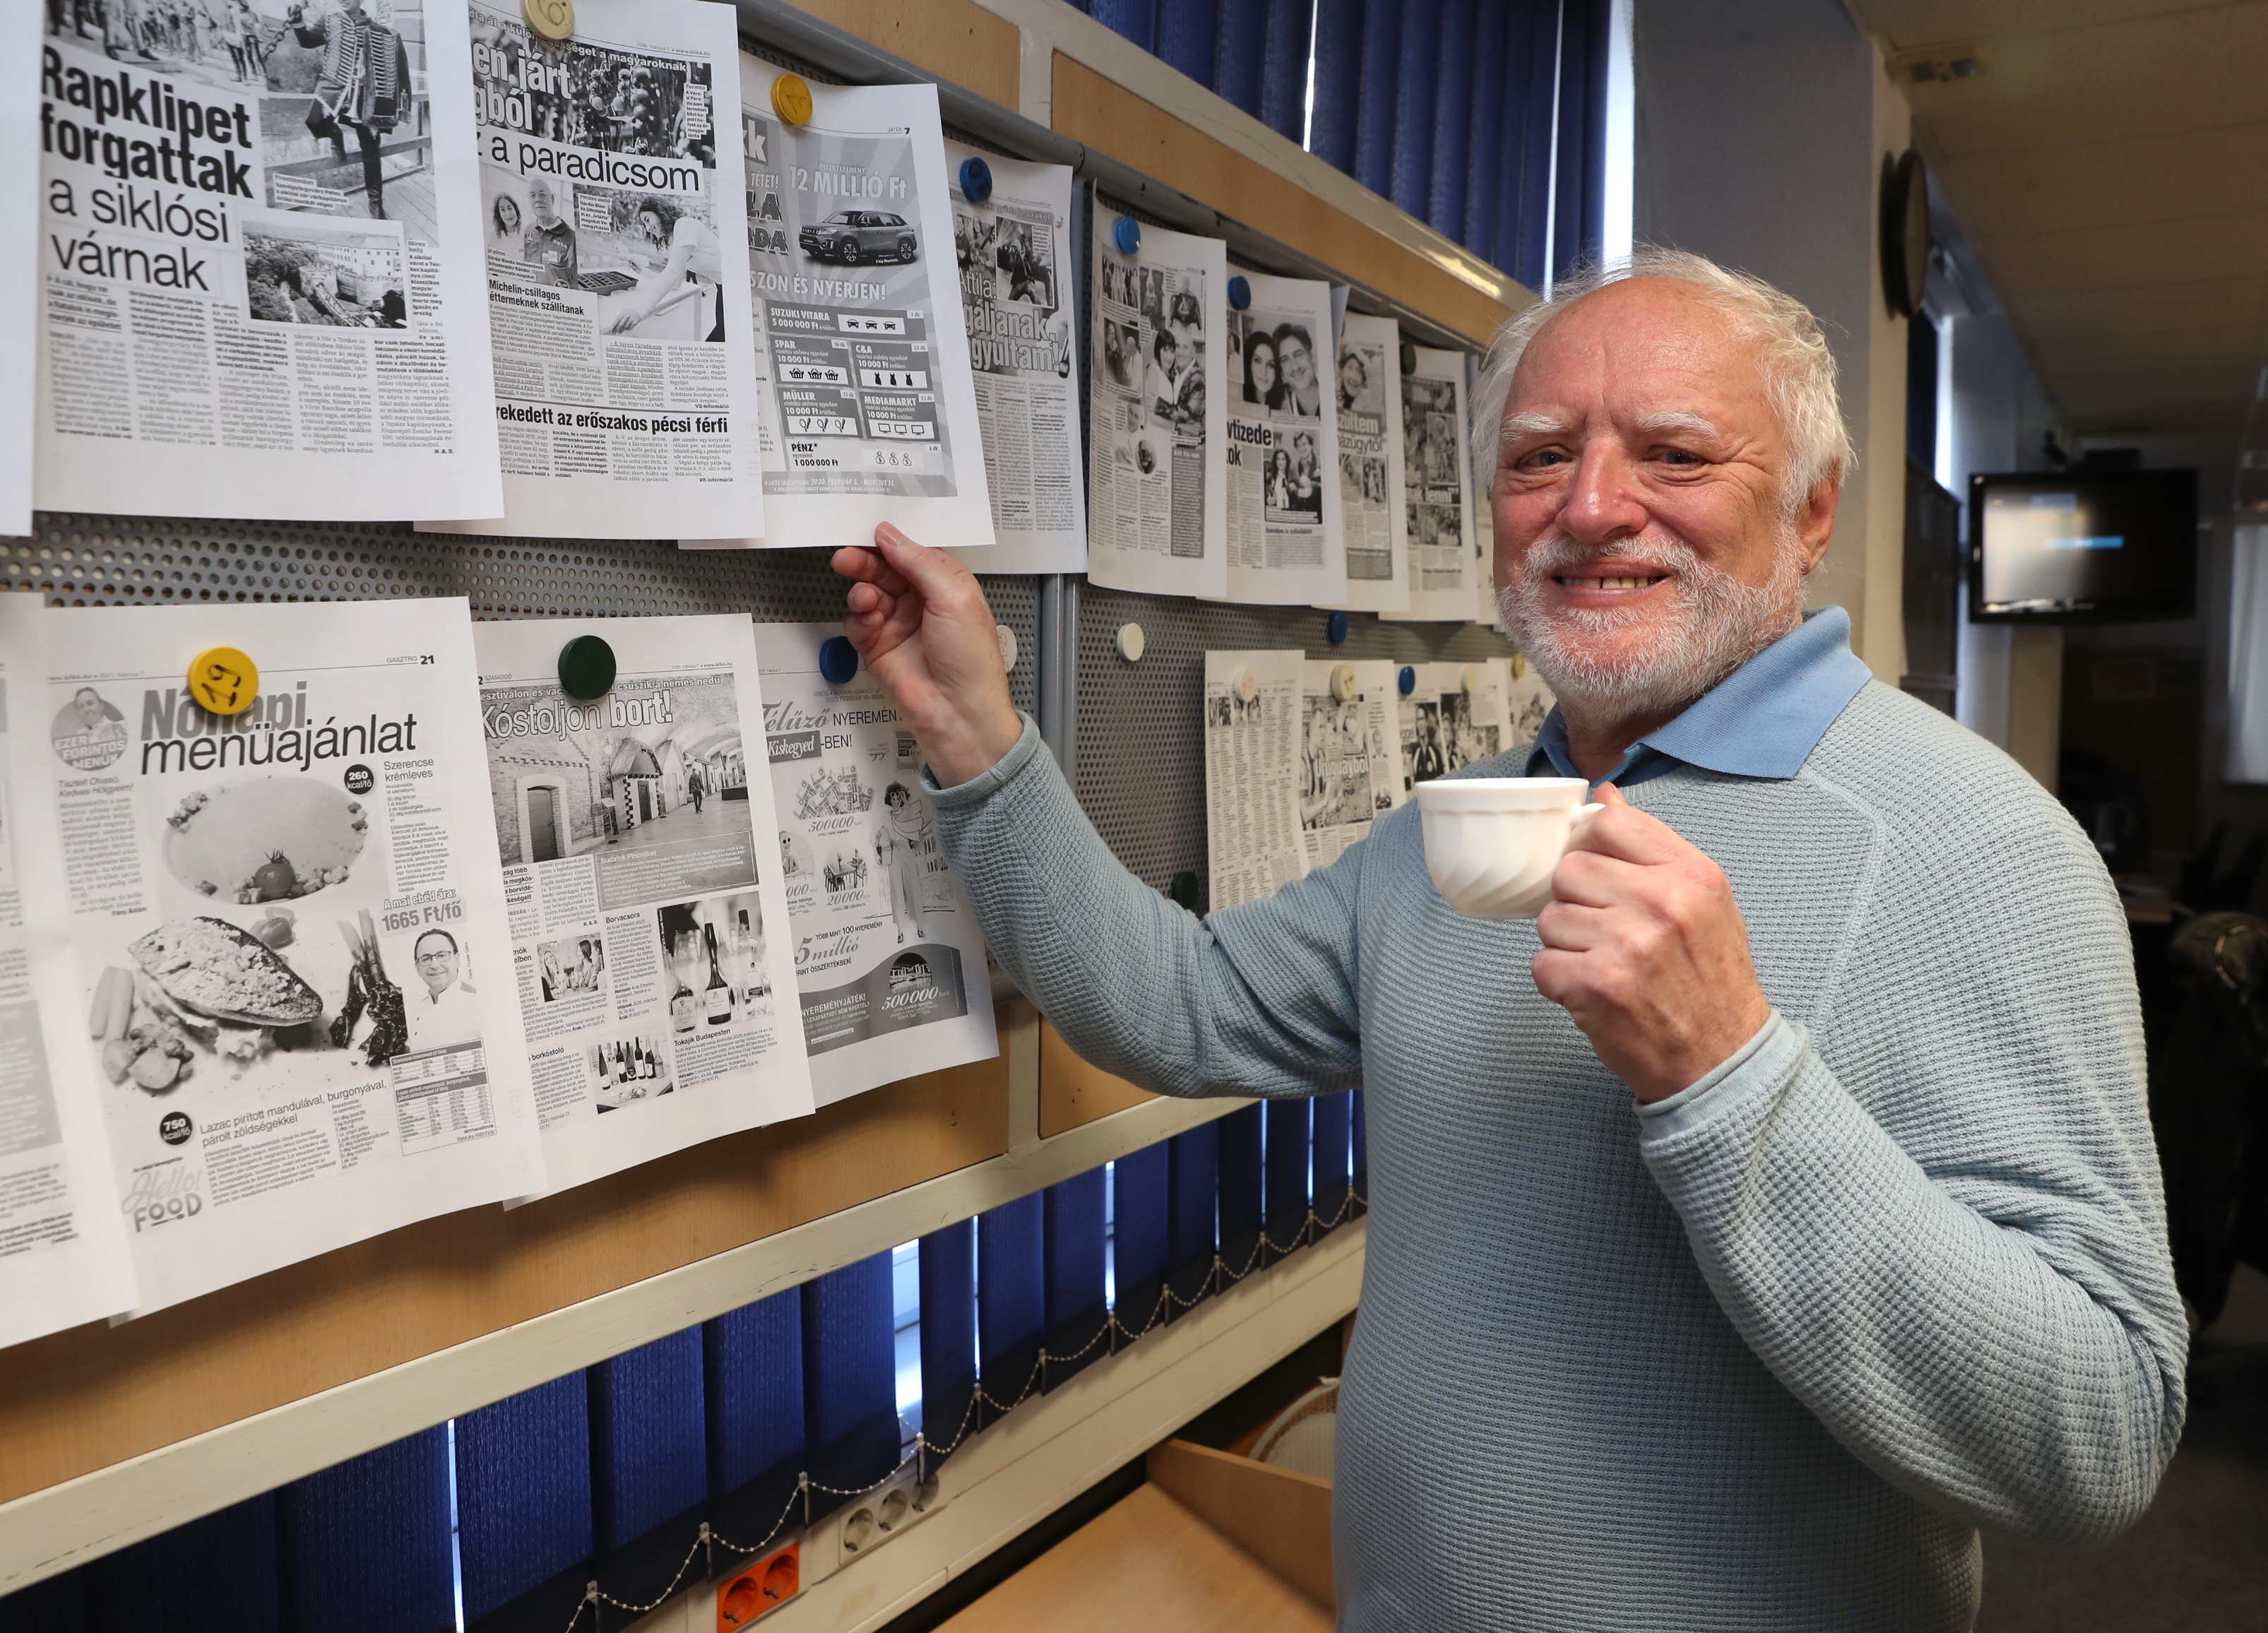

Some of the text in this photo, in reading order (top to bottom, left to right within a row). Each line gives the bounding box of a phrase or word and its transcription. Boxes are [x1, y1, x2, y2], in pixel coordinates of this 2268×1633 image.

[499, 22, 507, 31] a
[609, 53, 687, 72] magyaroknak
[517, 47, 571, 100] járt
[42, 44, 252, 157] Rapklipet
[42, 102, 254, 199] forgattak
[491, 136, 699, 191] a paradicsom
[819, 161, 866, 174] ÖSSZNYEREMÉNY
[751, 170, 779, 189] TÉTET!
[790, 165, 908, 199] 12 MILLIÓ Ft
[50, 179, 78, 216] a
[92, 182, 229, 243] siklósi
[52, 230, 209, 292] várnak
[516, 272, 535, 280] magokat
[958, 268, 997, 300] Attila:
[489, 280, 561, 301] Michelin-csillagos
[793, 273, 809, 295] ÉS
[813, 278, 886, 300] NYERJEN!
[489, 291, 585, 316] éttermeknek szállítanak
[770, 307, 831, 321] SUZUKI VITARA
[777, 319, 793, 328] 000
[795, 321, 811, 329] 000
[774, 339, 796, 349] SPAR
[855, 345, 872, 354] C&A
[783, 389, 816, 400] MÜLLER
[864, 396, 917, 407] MEDIAMARKT
[496, 404, 728, 434] rekedett az erőszakos pécsi férfi
[1227, 419, 1271, 446] vtizede
[420, 655, 435, 665] 21
[477, 676, 483, 684] 2
[481, 687, 529, 701] esztiválon
[532, 687, 543, 696] és
[663, 679, 694, 688] nemes
[696, 675, 721, 685] nedű
[482, 689, 673, 741] Kóstoljon bort!
[833, 707, 901, 726] NYEREMÉN
[55, 735, 88, 749] EZER
[62, 740, 125, 760] FORINTOS
[141, 713, 417, 775] menüajánlat
[768, 734, 853, 759] Kiskegyed -BEN!
[384, 759, 434, 771] Szerencse
[347, 779, 372, 789] kcal/fő
[348, 771, 368, 781] 260
[385, 770, 434, 782] krémleves
[600, 850, 657, 864] Budafok Pincejárat
[509, 885, 533, 893] borvidé-
[384, 888, 456, 910] A mai ebéd ára:
[381, 900, 462, 931] 1665 Ft/fő
[605, 913, 641, 923] Borvacsora
[843, 925, 855, 934] 100
[855, 921, 883, 932] NYEREMÉNY
[794, 935, 860, 965] 5 millió
[810, 956, 852, 973] ÖSSZÉRTÉKBEN!
[674, 1028, 731, 1047] Tokajik Budapesten
[531, 1046, 565, 1061] borkóstoló
[200, 1079, 387, 1134] Lazac pirított mandulával, burgonyával,
[164, 1117, 186, 1131] 750
[202, 1113, 299, 1149] párolt zöldségekkel
[133, 1193, 203, 1233] FOOD
